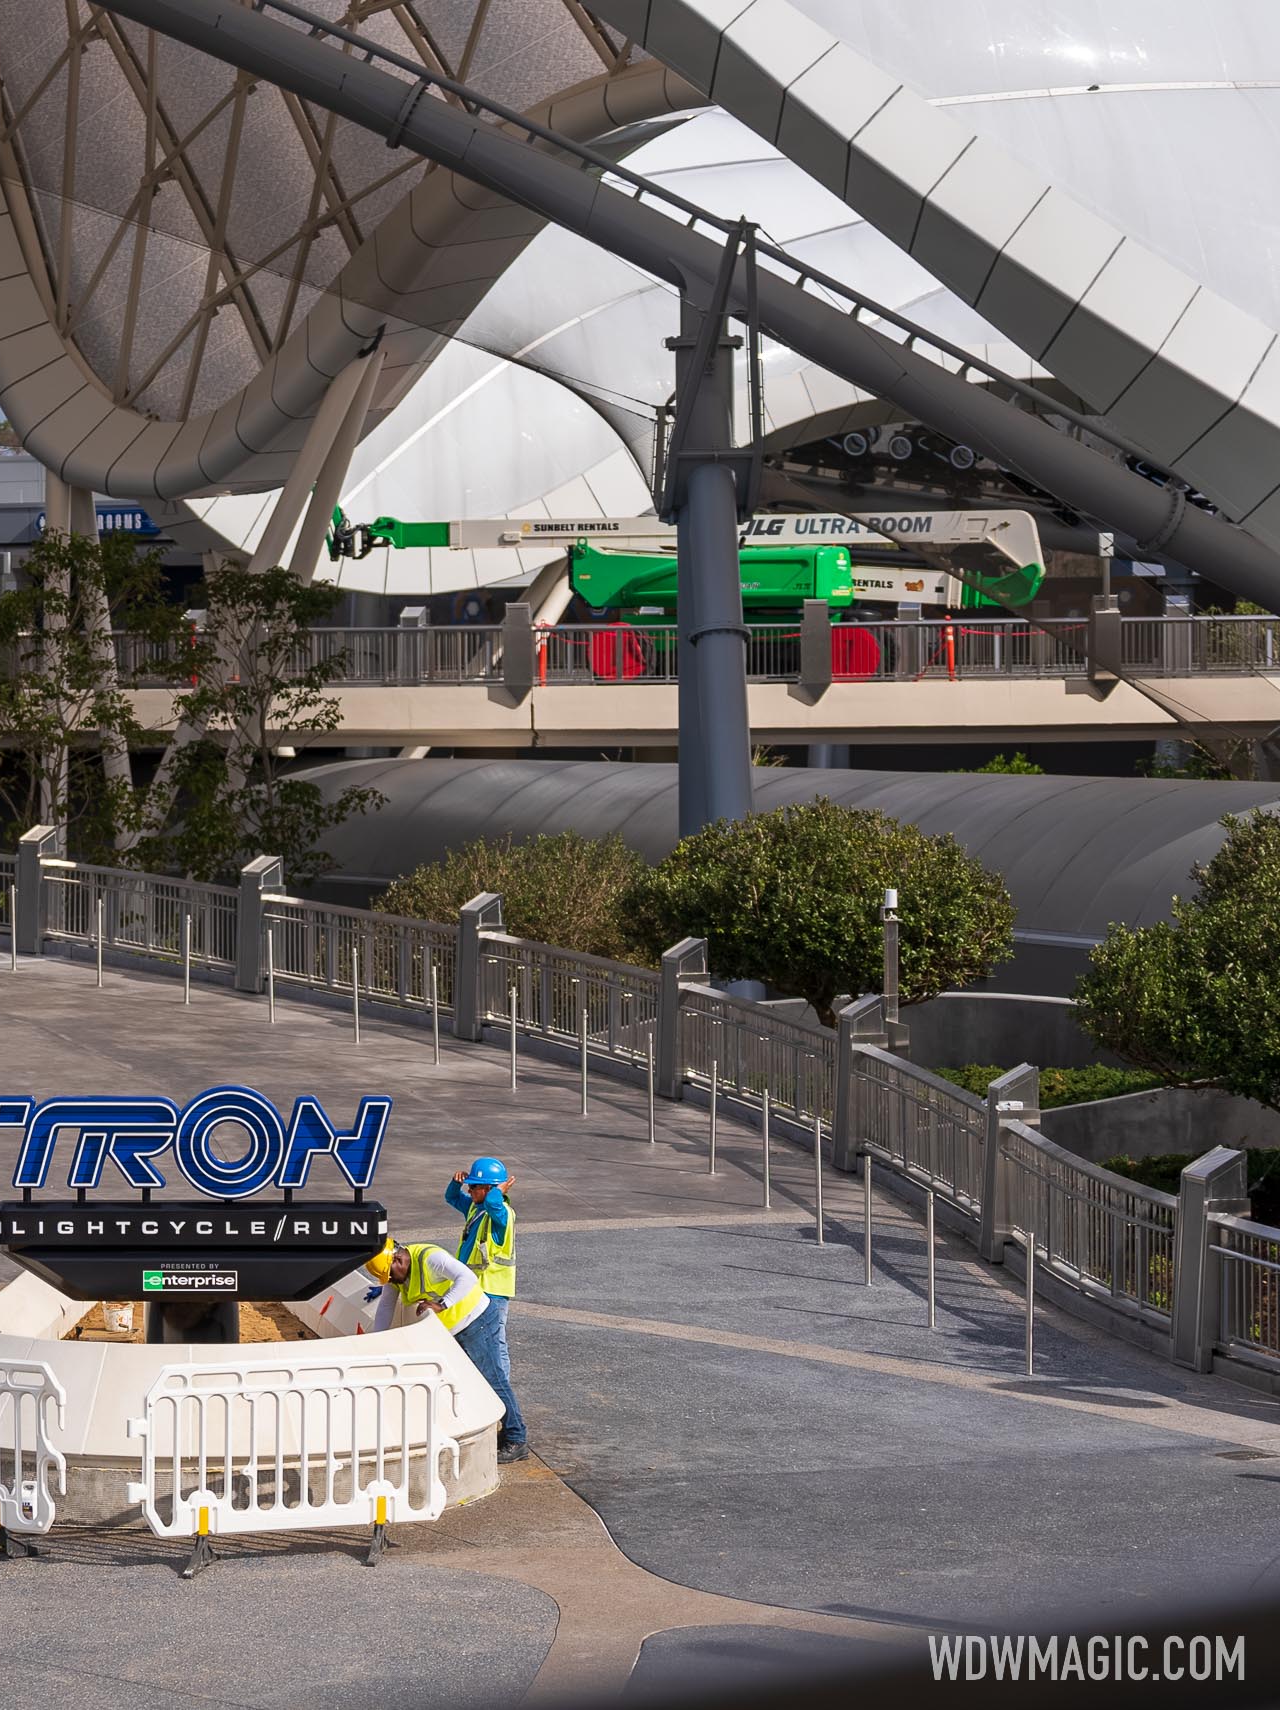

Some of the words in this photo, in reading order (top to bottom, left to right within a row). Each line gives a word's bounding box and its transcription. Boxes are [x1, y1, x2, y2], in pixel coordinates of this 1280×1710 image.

[96, 513, 142, 530] ROOMS
[534, 523, 575, 532] SUNBELT
[577, 522, 619, 531] RENTALS
[739, 519, 786, 536] JLG
[795, 518, 860, 535] ULTRA
[867, 516, 933, 534] BOOM
[143, 1274, 235, 1288] enterprise
